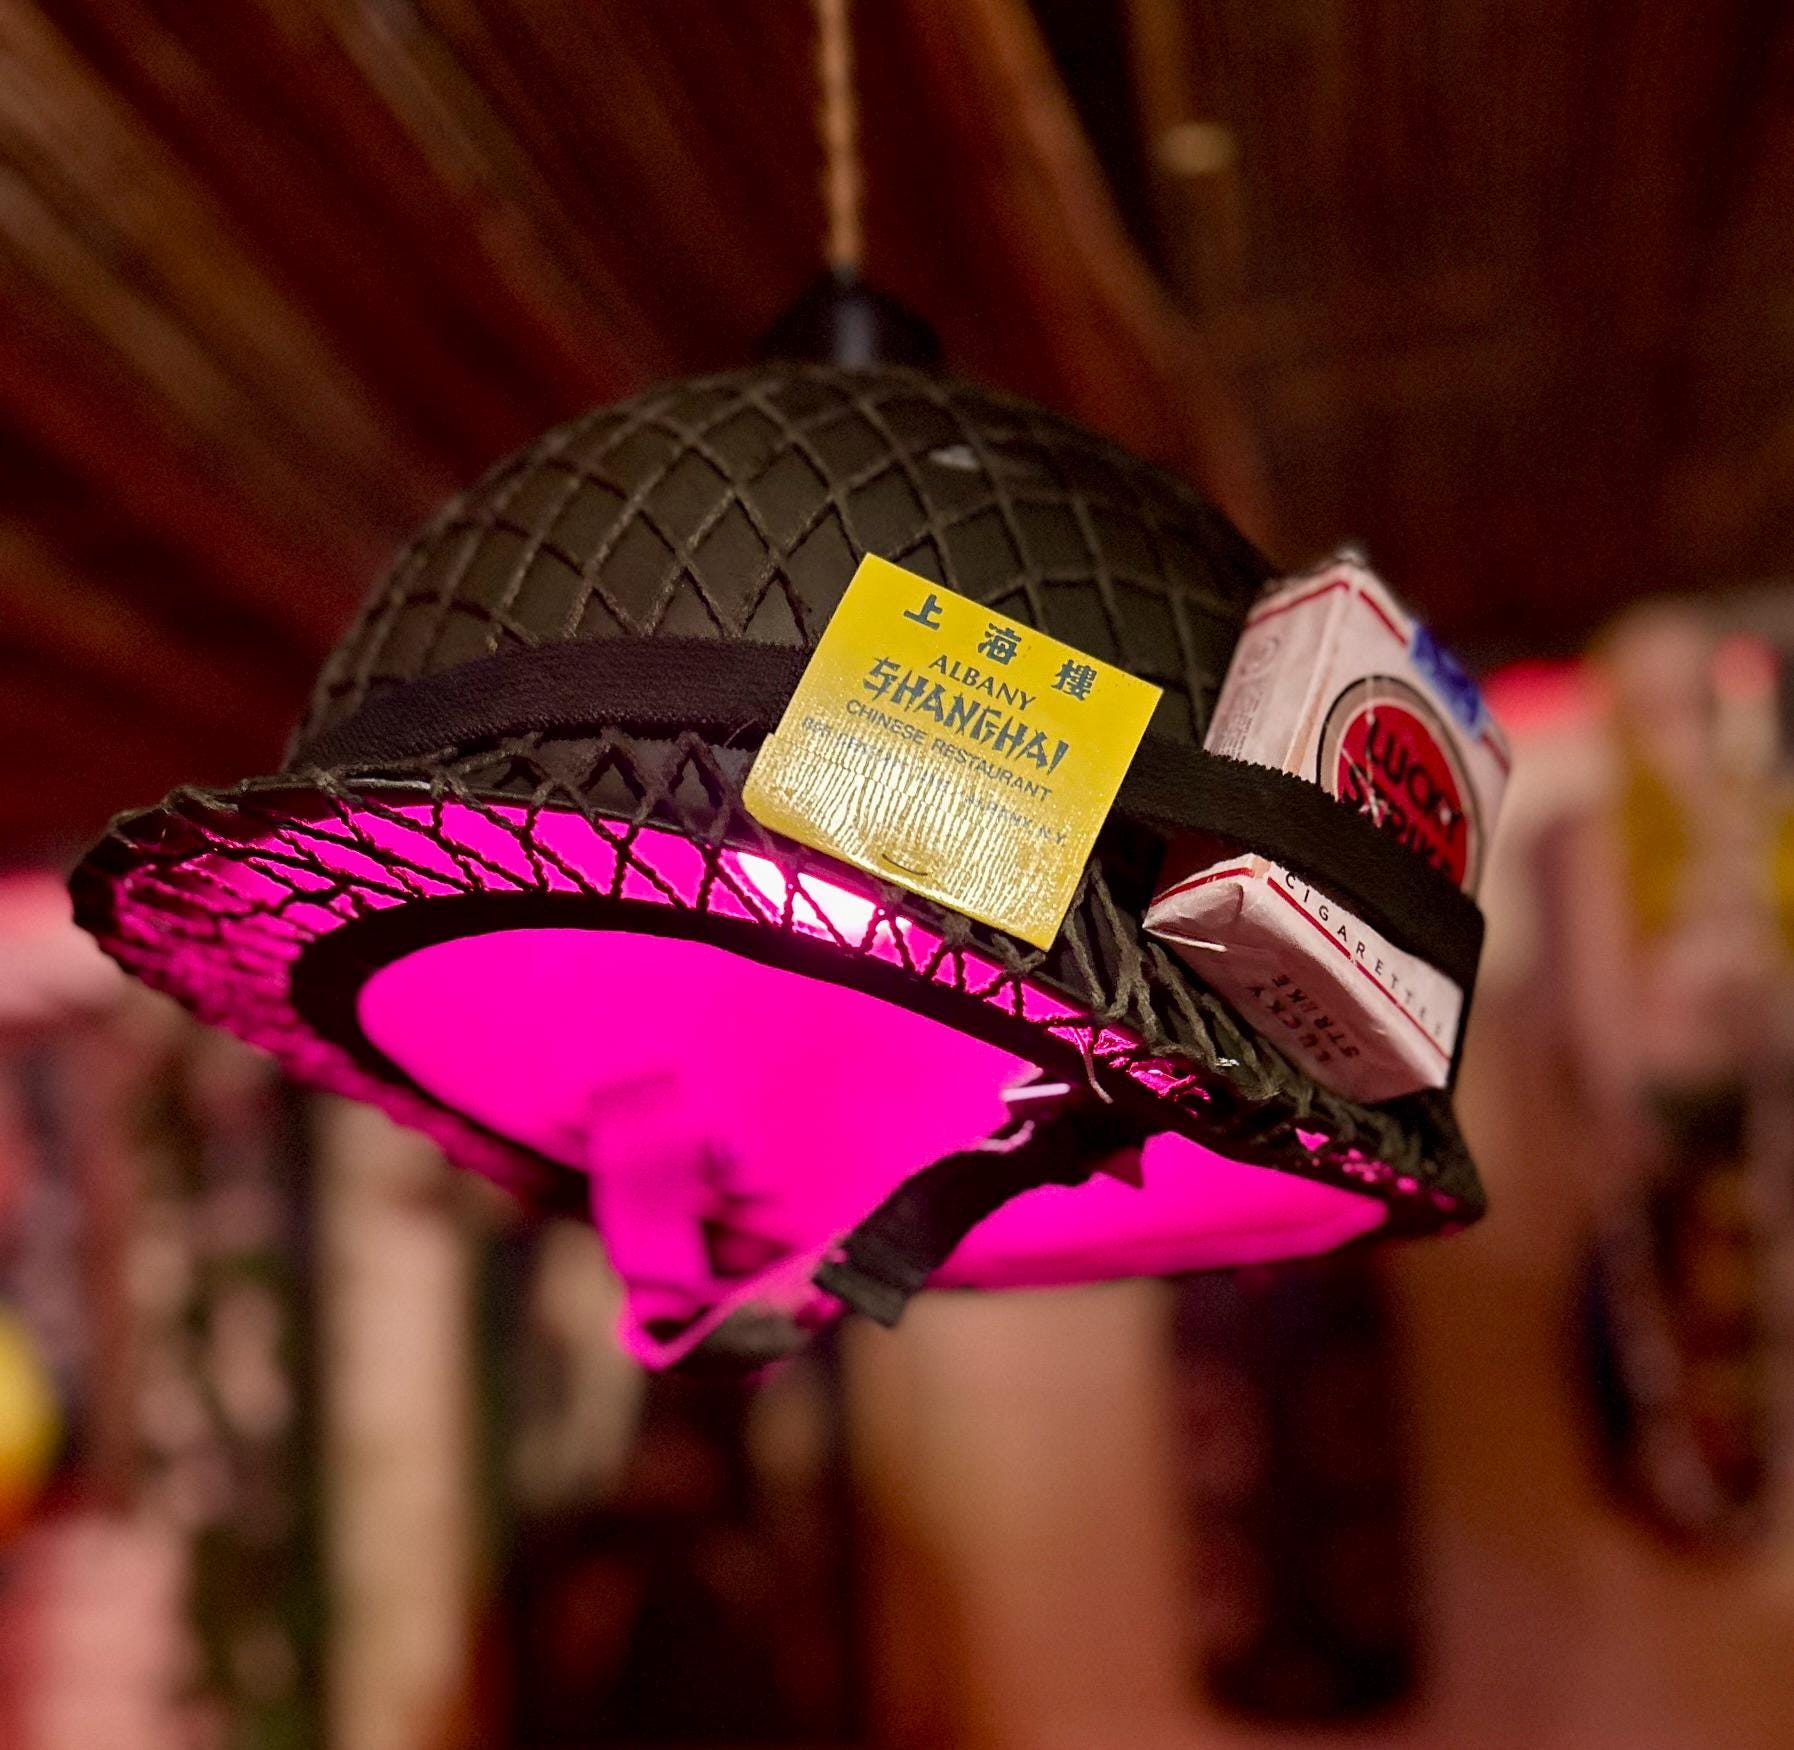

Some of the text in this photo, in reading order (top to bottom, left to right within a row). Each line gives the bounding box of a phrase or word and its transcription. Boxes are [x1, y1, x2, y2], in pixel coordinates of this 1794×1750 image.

[903, 593, 1099, 701] 上海樓
[928, 654, 1037, 712] ALBANY
[846, 699, 928, 745] CHINESE
[930, 738, 1053, 803] RESTAURANT
[862, 656, 1070, 776] SHANGHAI
[1246, 983, 1331, 1063] LUCKY
[1271, 974, 1361, 1059] STRIKE
